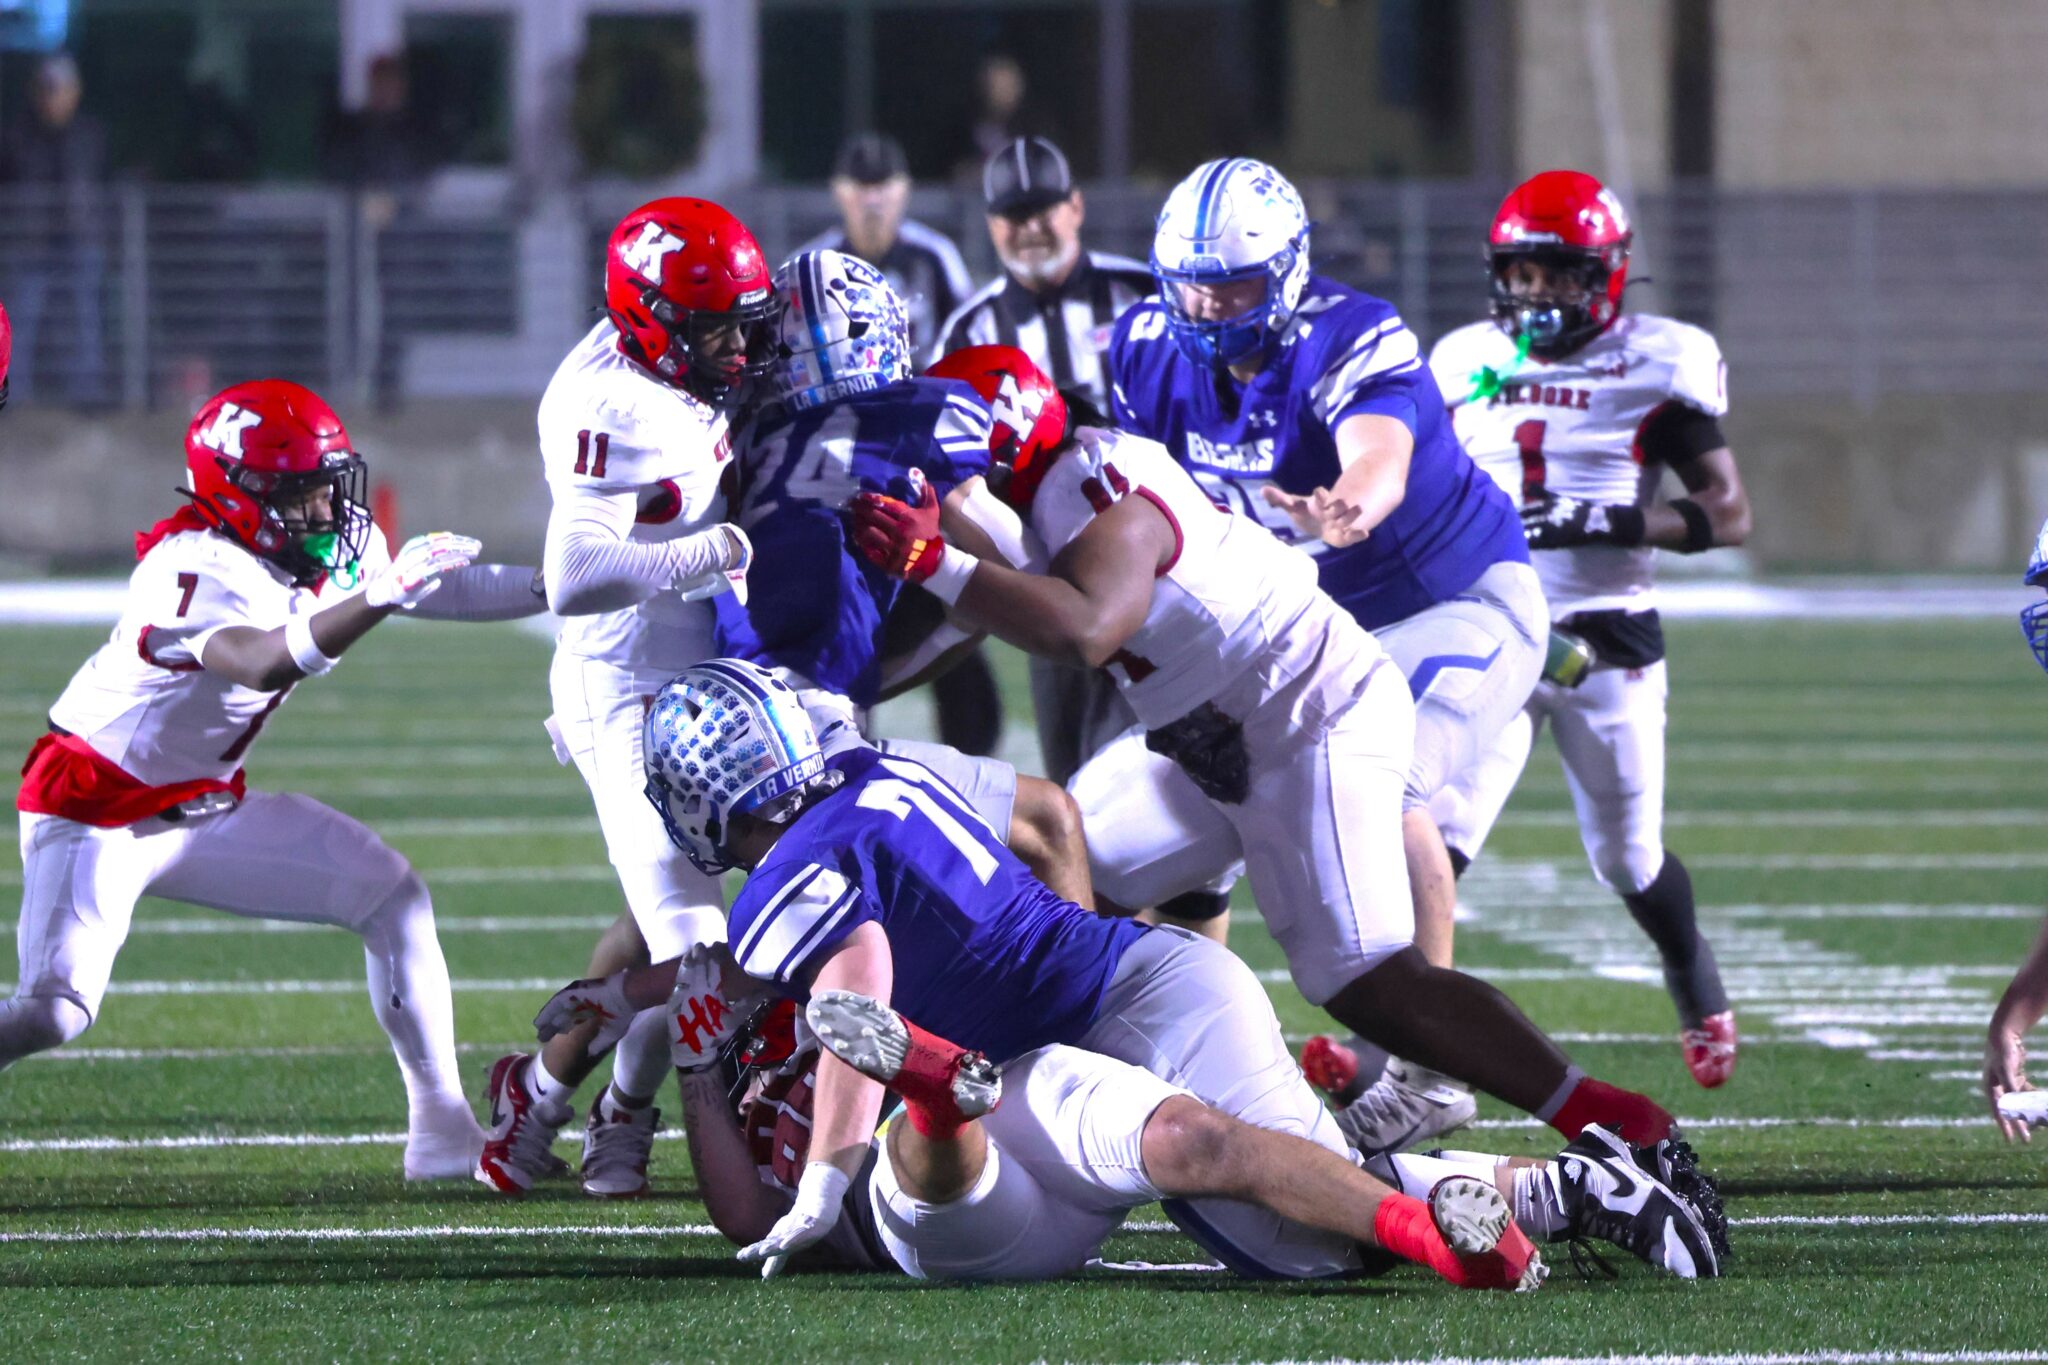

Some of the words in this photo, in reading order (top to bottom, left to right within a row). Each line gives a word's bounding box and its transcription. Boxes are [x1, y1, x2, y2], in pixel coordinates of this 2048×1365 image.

[621, 220, 687, 287] K
[816, 372, 879, 404] VERNIA
[992, 373, 1045, 444] K
[200, 402, 263, 461] K
[574, 429, 610, 478] 11
[1513, 419, 1547, 504] 1
[176, 572, 199, 618] 7
[755, 778, 779, 805] LA
[782, 752, 825, 788] VERNIA
